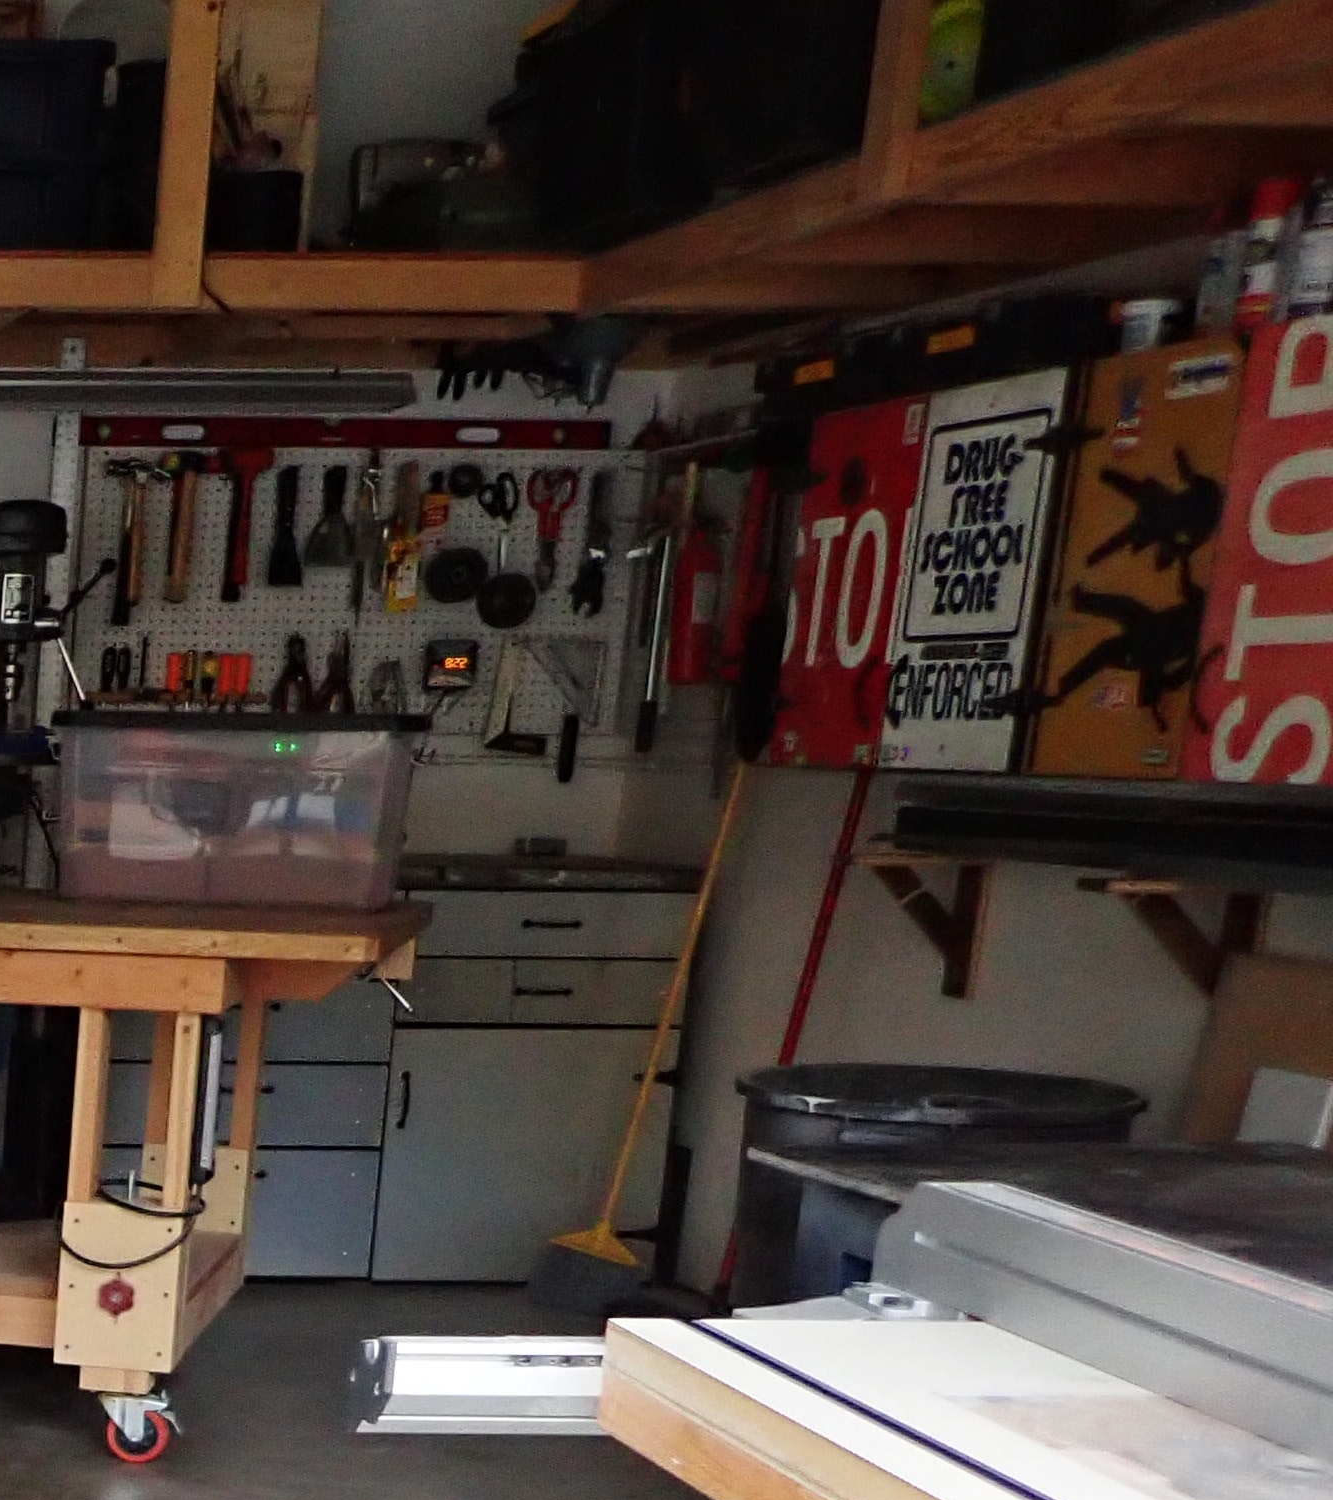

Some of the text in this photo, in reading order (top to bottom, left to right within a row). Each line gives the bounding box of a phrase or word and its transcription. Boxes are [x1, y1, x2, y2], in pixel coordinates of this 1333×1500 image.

[944, 433, 1024, 485] DRUG
[948, 480, 1009, 528] FREE
[920, 523, 1025, 573] SCHOOL
[932, 571, 1001, 615] ZONE
[889, 661, 1014, 720] ENFORCED
